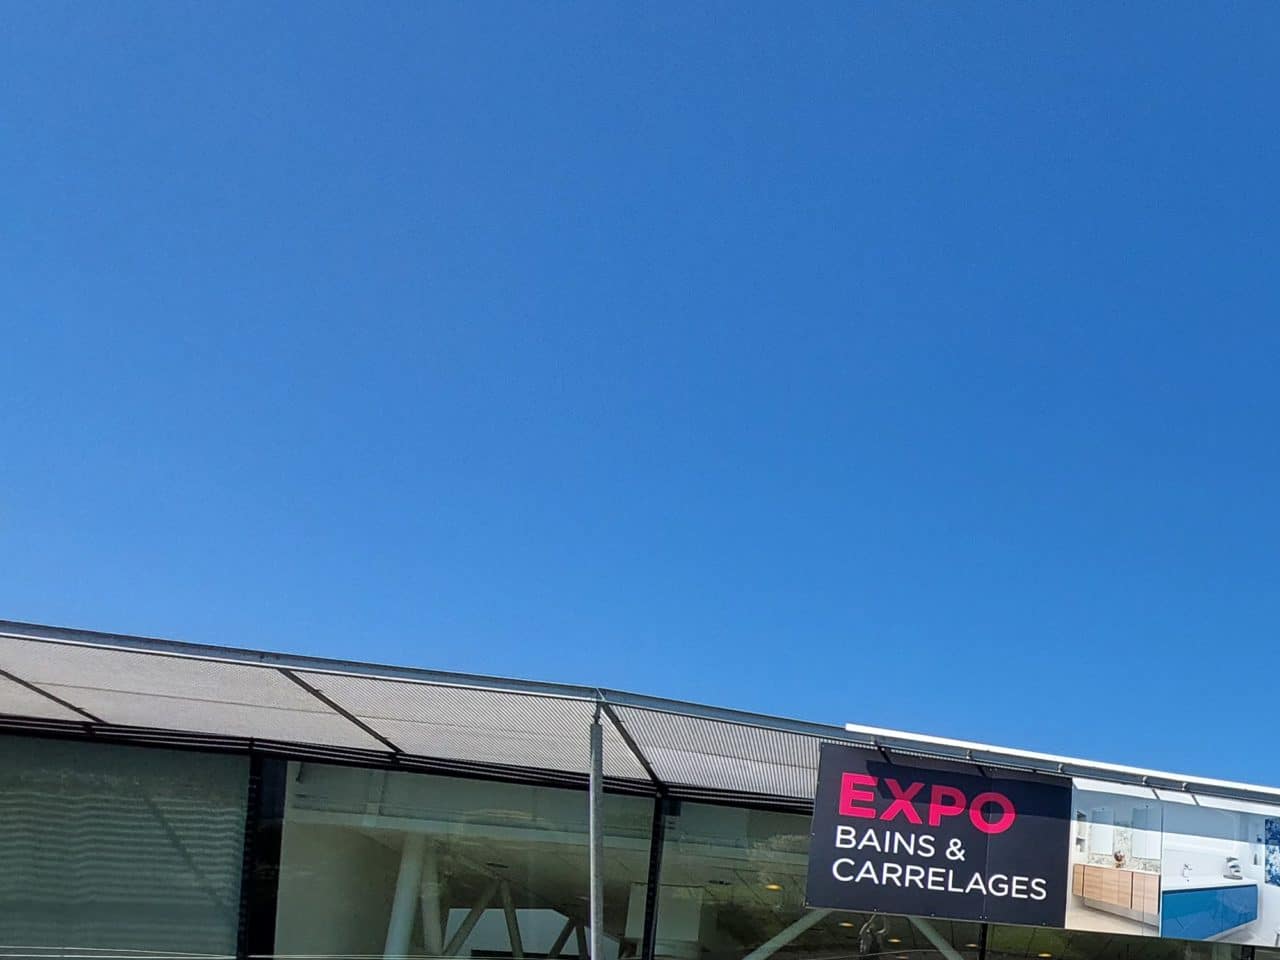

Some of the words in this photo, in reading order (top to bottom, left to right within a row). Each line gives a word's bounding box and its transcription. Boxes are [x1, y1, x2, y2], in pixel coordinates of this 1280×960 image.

[839, 772, 1016, 834] EXPO
[835, 825, 935, 858] BAINS
[945, 838, 966, 861] &
[832, 858, 1048, 901] CARRELAGES
